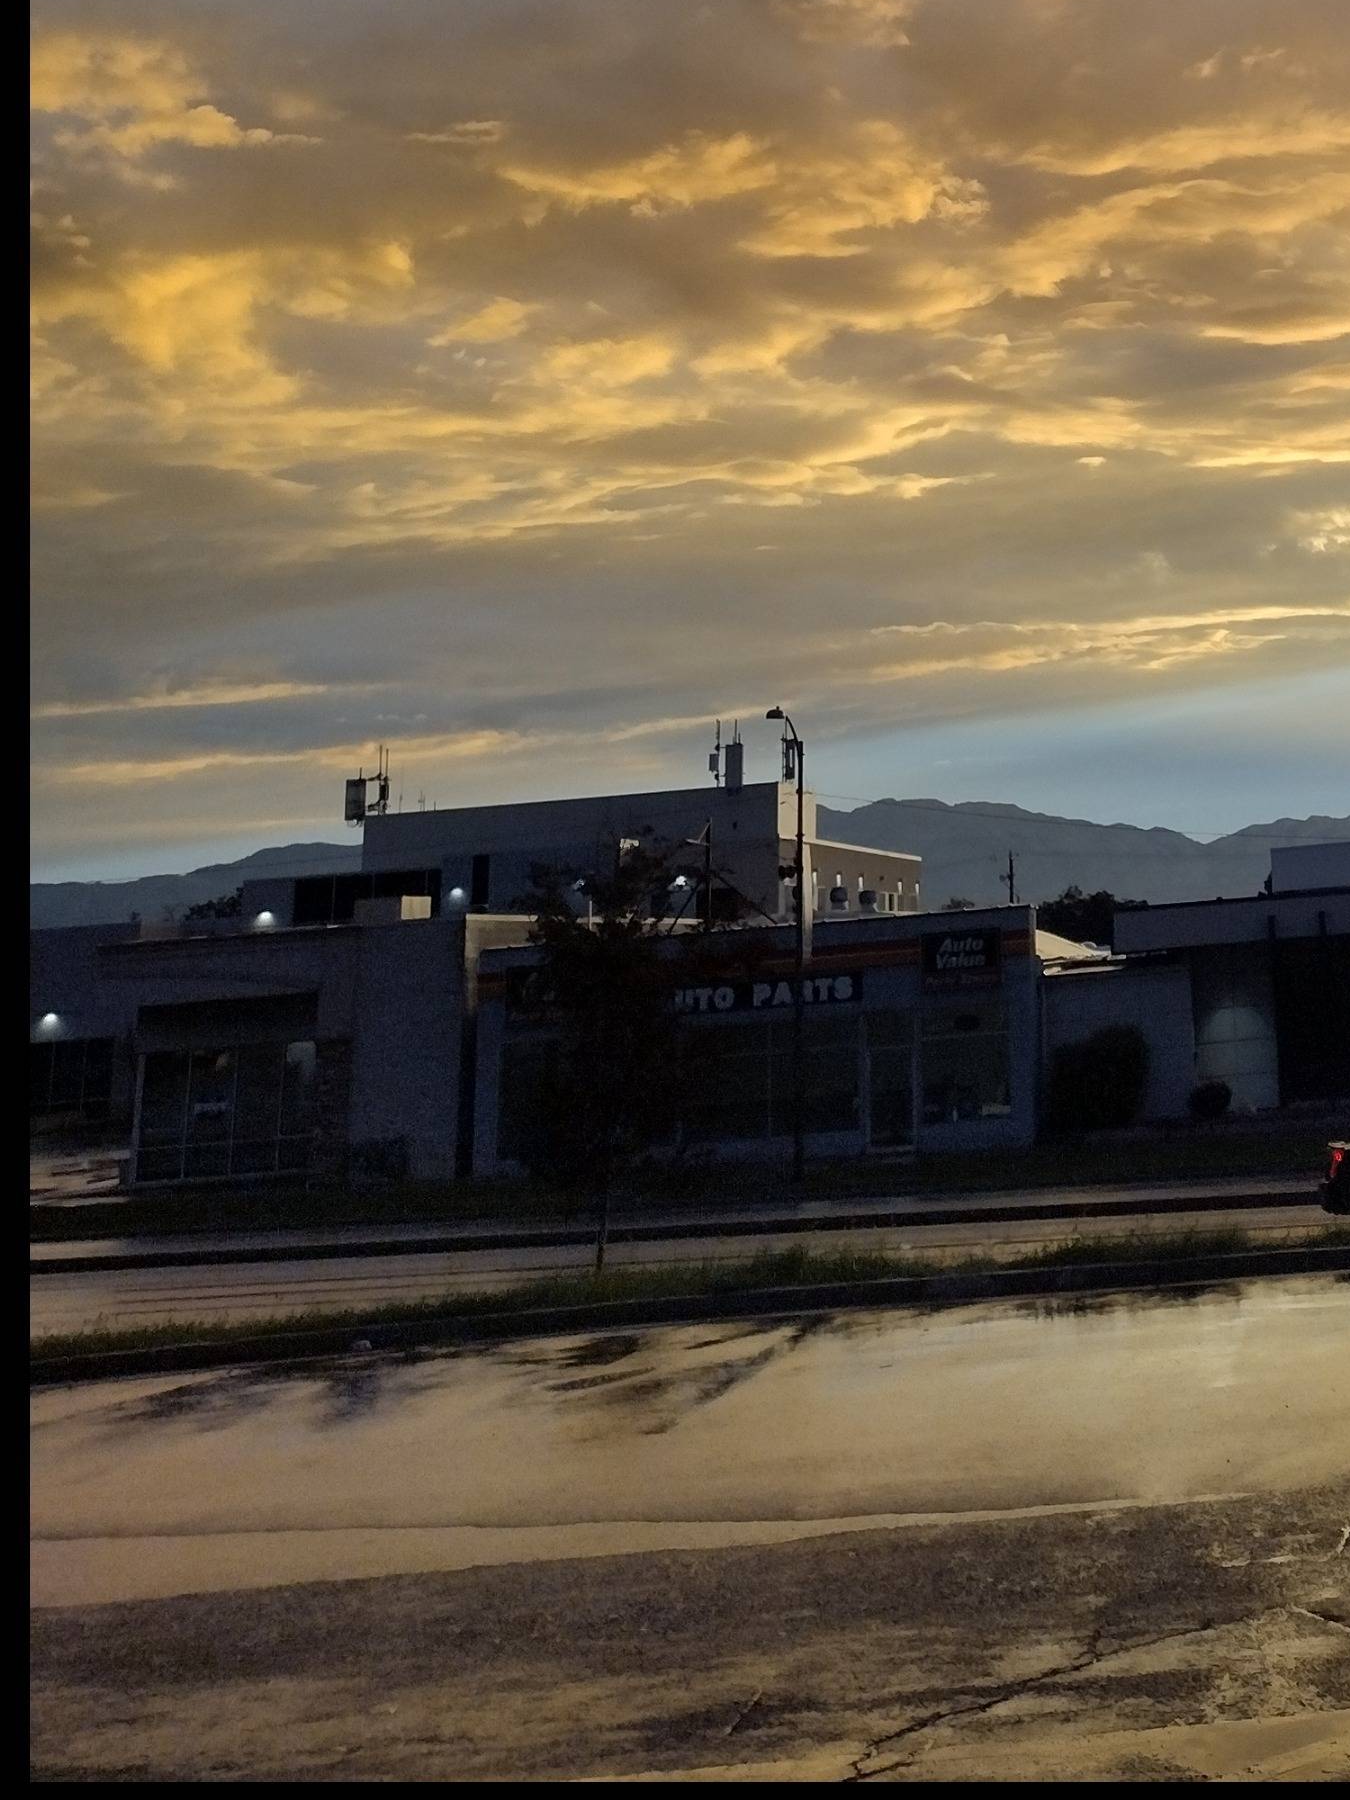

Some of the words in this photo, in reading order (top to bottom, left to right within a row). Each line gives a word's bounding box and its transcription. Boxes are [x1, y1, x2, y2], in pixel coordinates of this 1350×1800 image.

[938, 935, 985, 953] Auto
[935, 950, 987, 969] Value
[674, 986, 735, 1011] UTO
